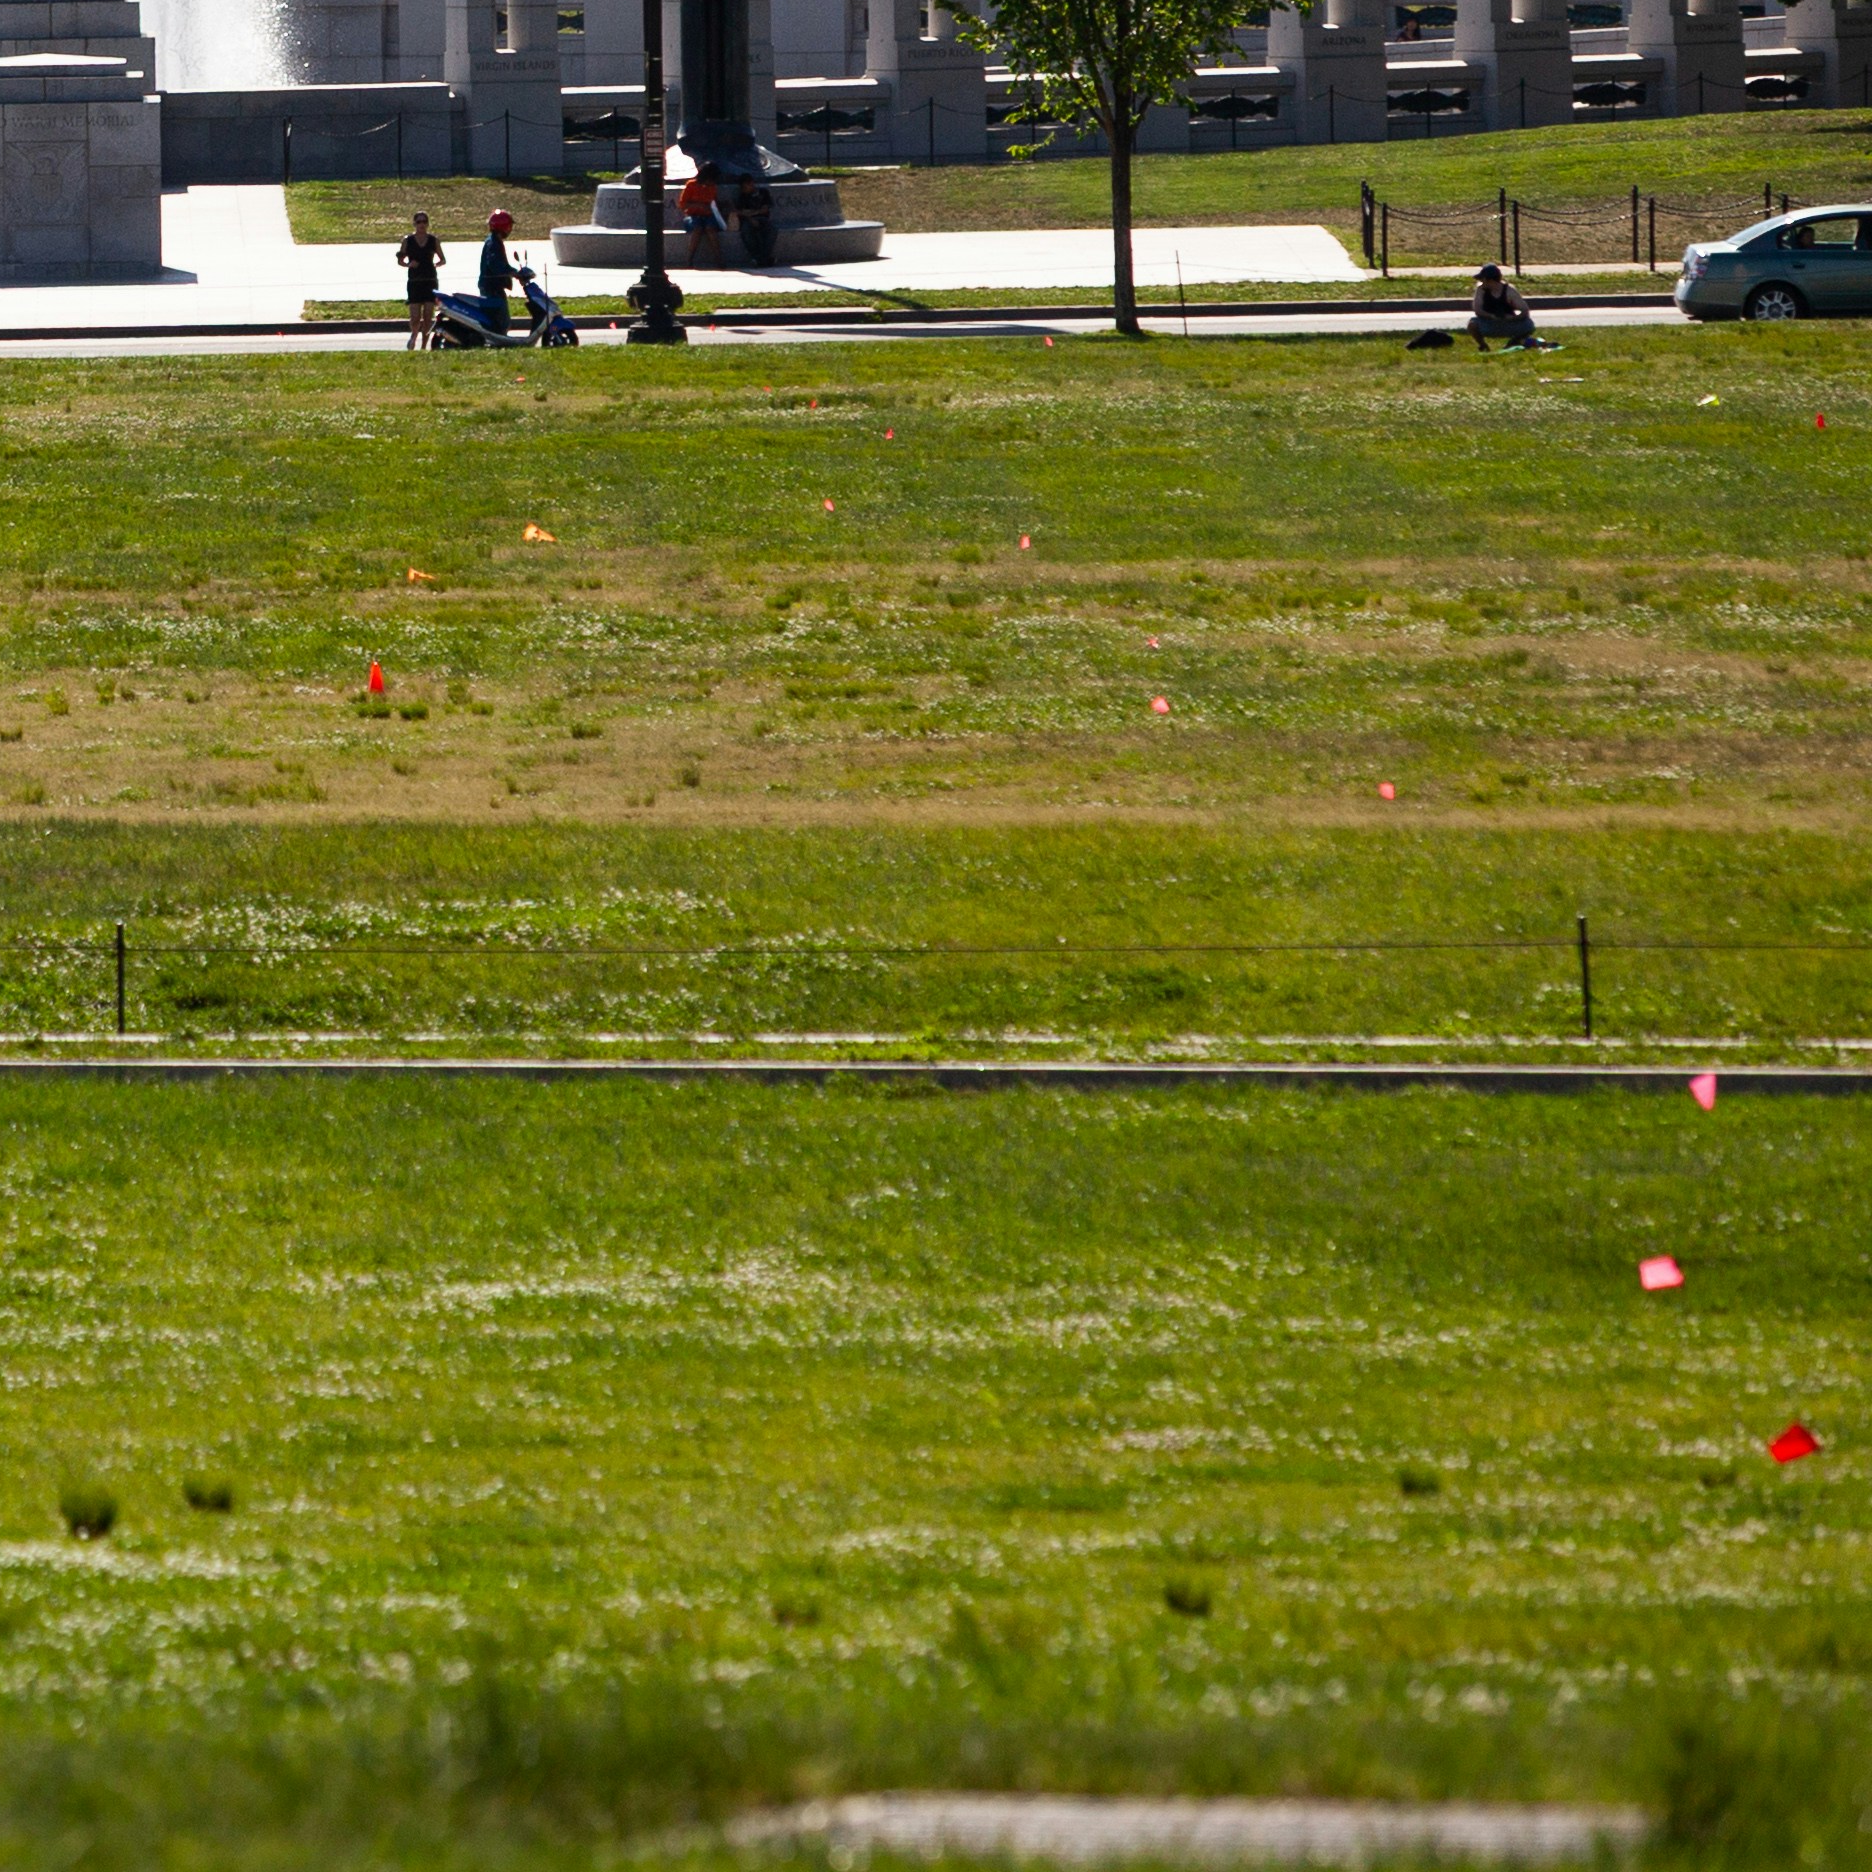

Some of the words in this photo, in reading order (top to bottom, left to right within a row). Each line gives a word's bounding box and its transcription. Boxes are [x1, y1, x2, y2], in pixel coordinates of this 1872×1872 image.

[1506, 30, 1561, 40] OKLAHOMA
[1321, 36, 1367, 47] ARIZONA
[907, 48, 947, 59] PUERTO
[948, 47, 975, 57] RICO
[474, 61, 510, 72] VIRGIN
[513, 59, 556, 71] ISLANDS
[62, 115, 136, 128] MEMORIAL
[617, 196, 640, 210] END
